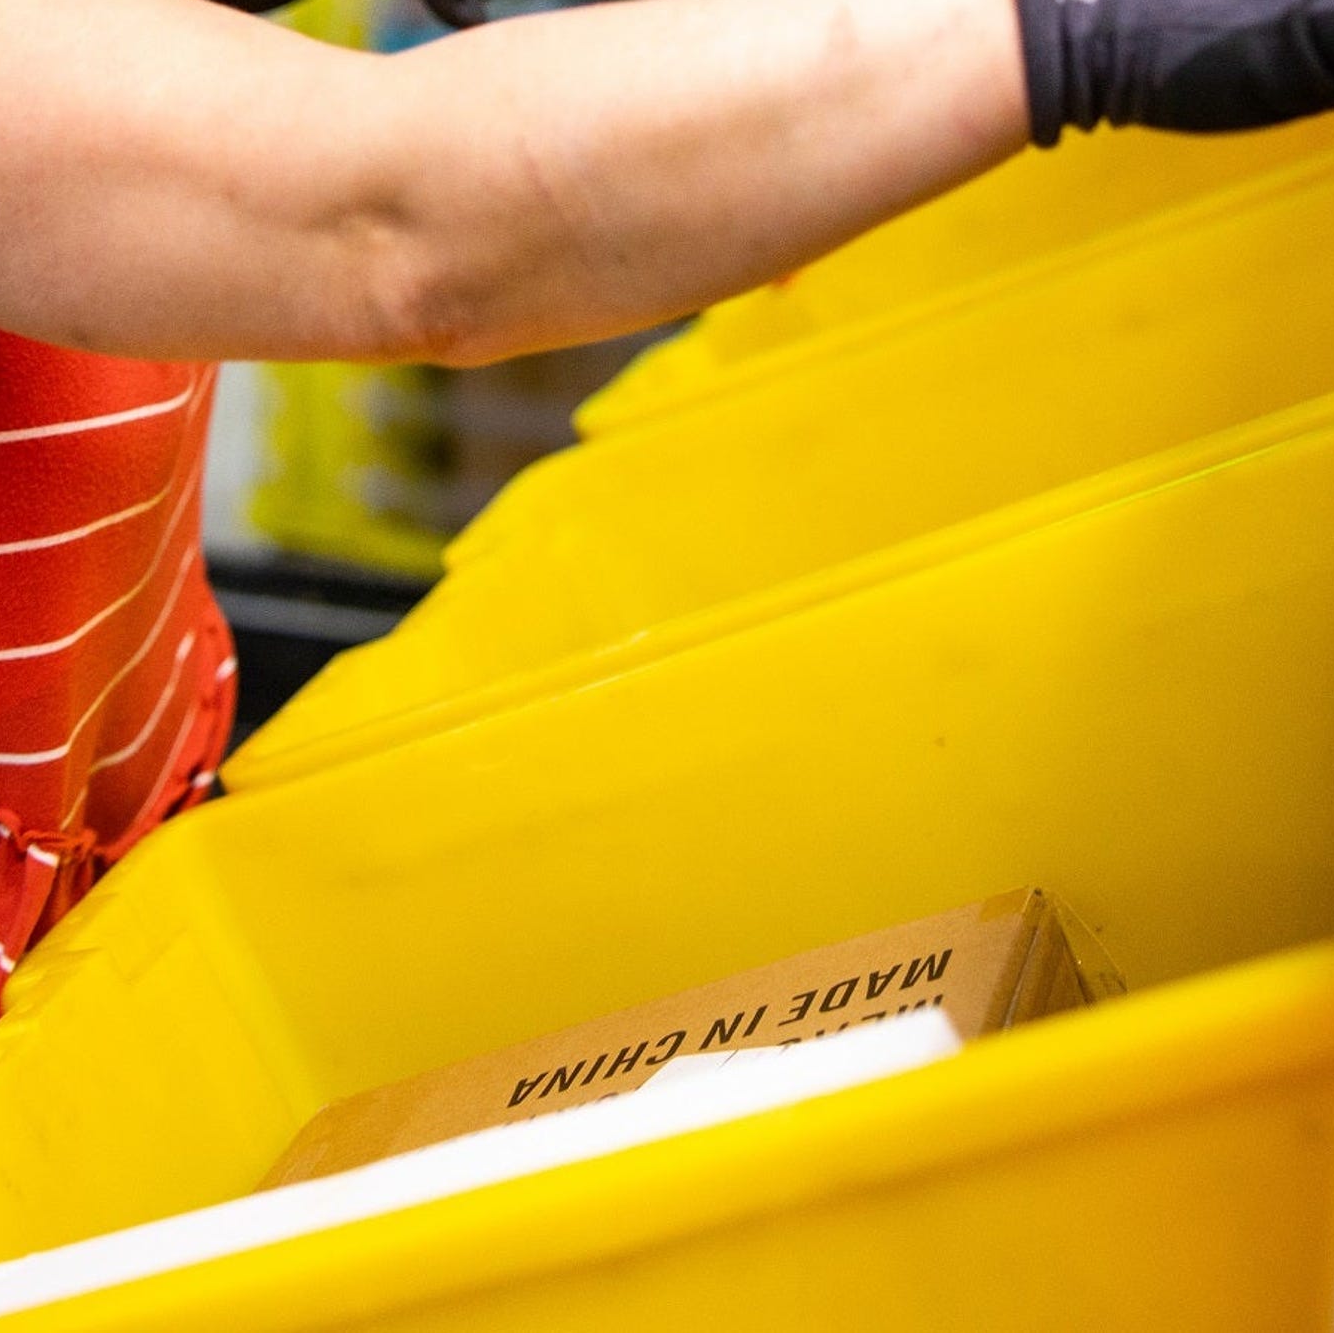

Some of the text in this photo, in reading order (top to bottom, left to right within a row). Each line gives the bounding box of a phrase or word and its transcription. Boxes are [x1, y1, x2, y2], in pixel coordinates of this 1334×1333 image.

[777, 948, 953, 1027] MADE
[698, 1004, 769, 1051] IN
[506, 1030, 687, 1108] CHINA
